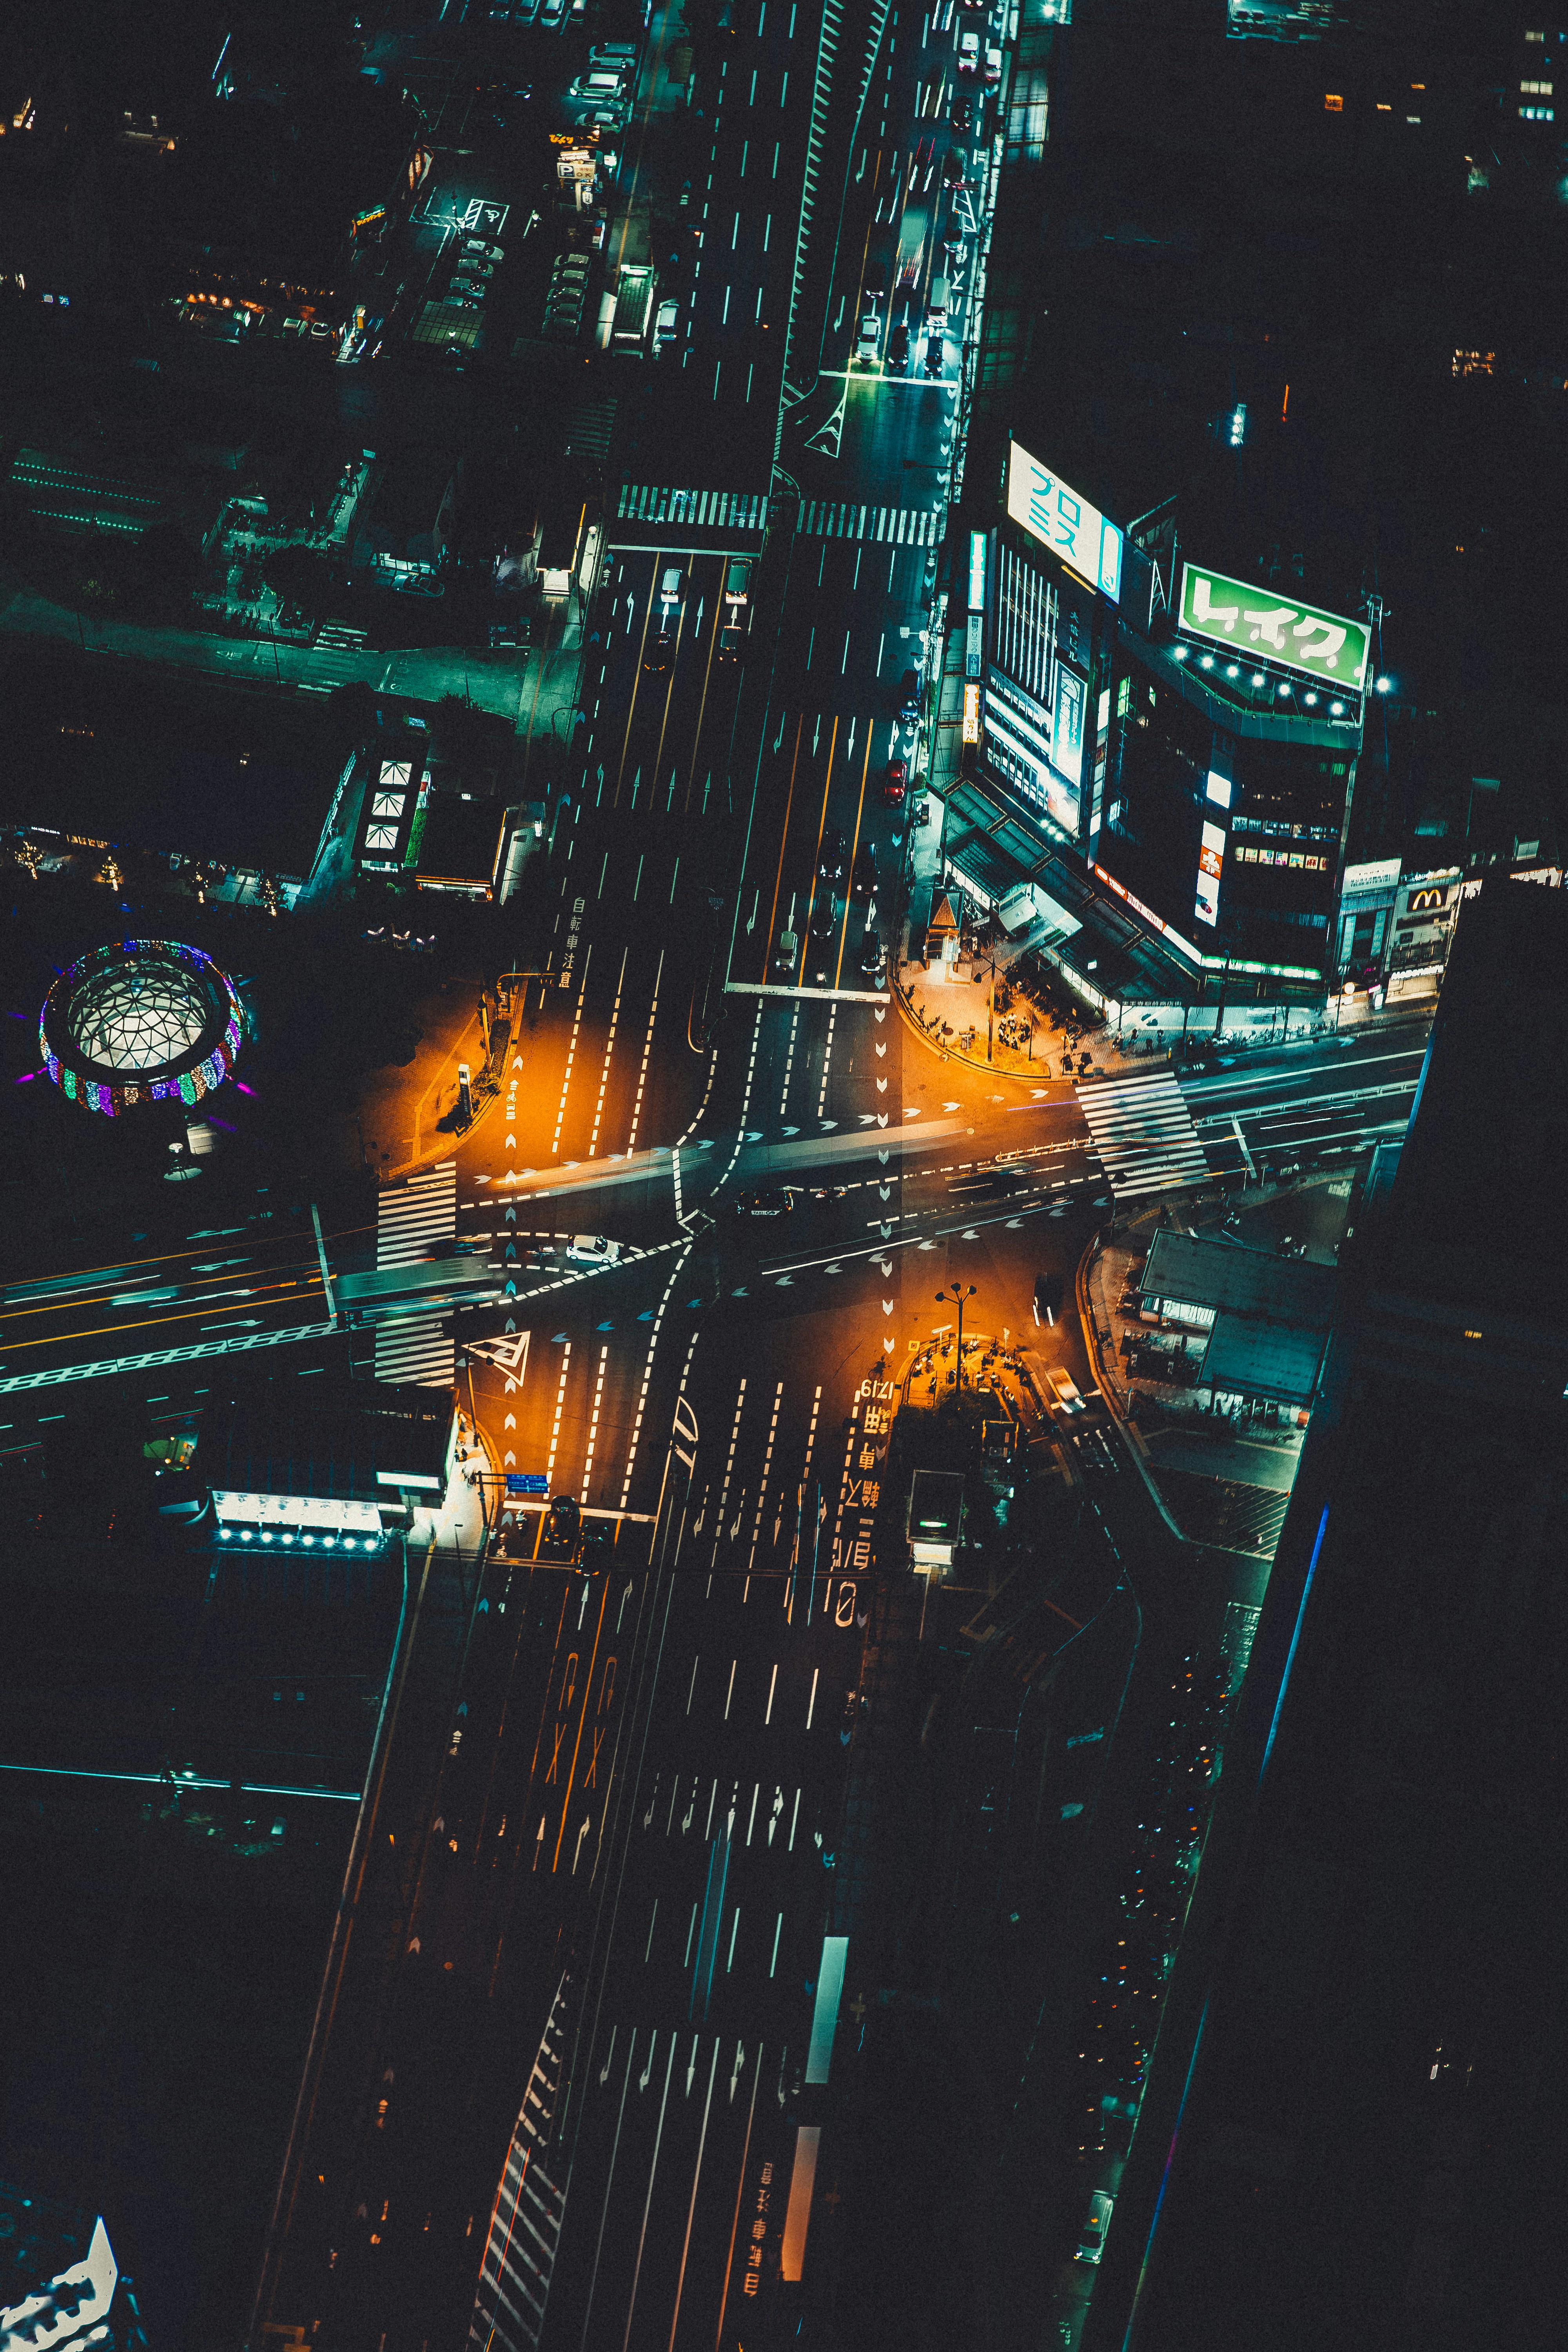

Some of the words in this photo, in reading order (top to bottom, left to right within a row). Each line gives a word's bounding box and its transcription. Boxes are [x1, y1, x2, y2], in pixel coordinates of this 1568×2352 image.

[1029, 497, 1077, 558] ミス
[1030, 466, 1081, 529] プロ
[1193, 577, 1347, 657] レイク
[390, 659, 409, 691] STOP
[559, 897, 585, 988] 自転車注意
